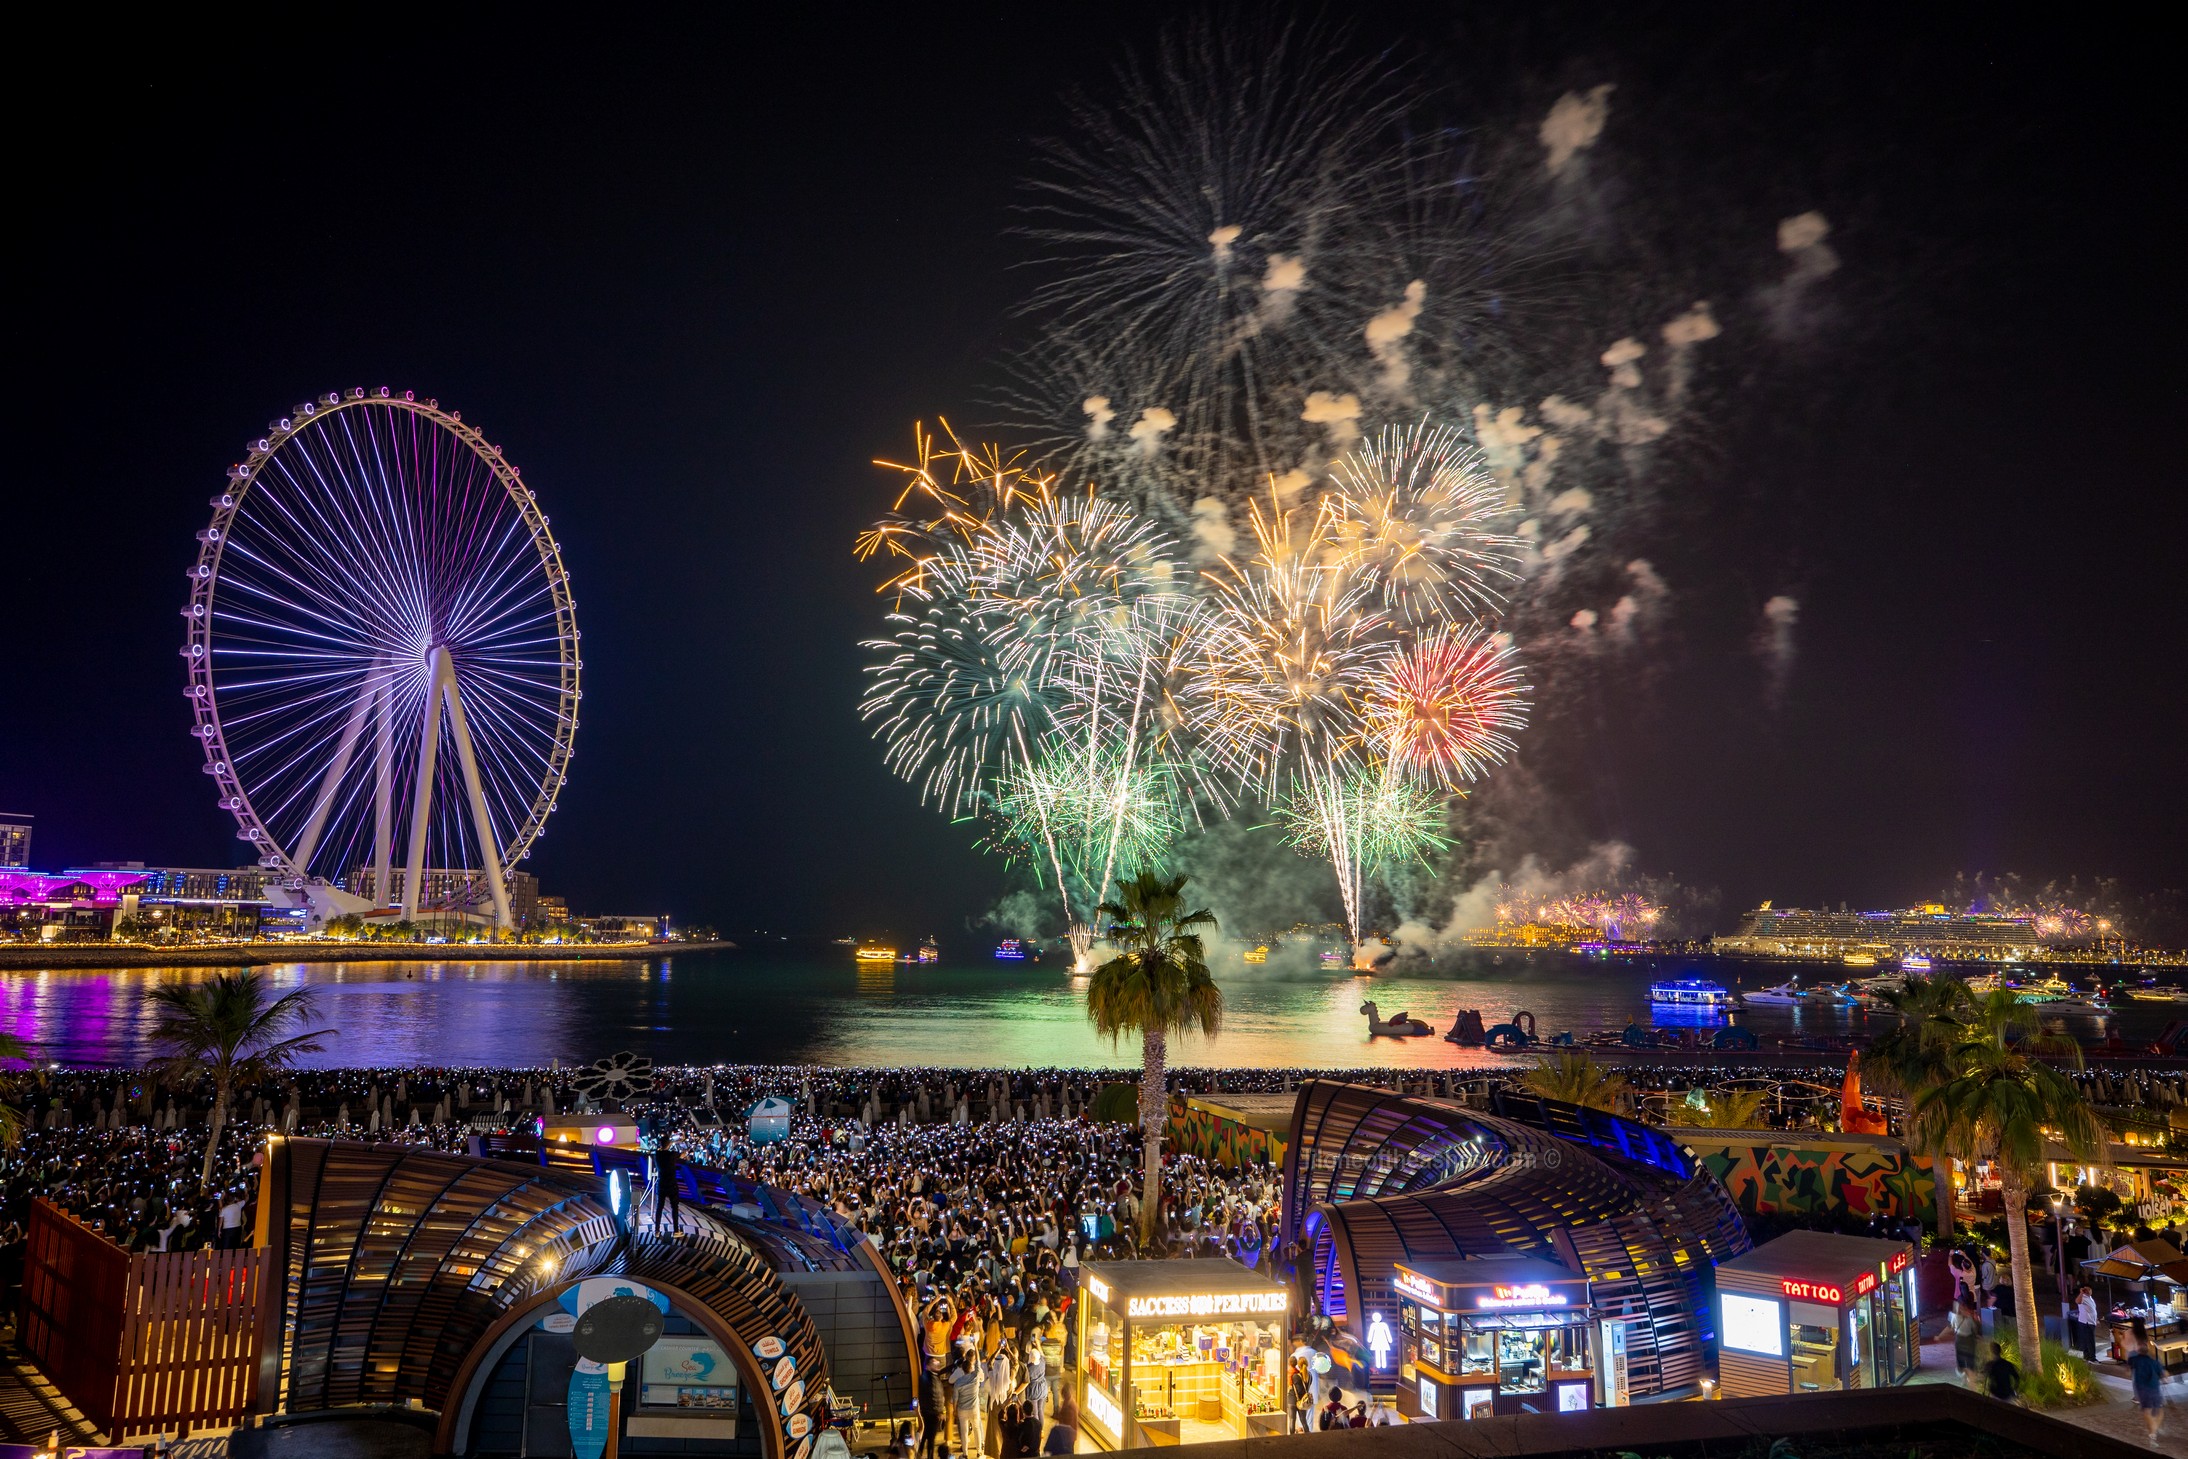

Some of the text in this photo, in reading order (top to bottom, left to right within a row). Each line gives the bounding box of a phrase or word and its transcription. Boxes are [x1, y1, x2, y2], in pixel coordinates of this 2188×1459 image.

[1783, 1281, 1840, 1302] TATTOO
[1858, 1273, 1874, 1294] TATTOO
[1129, 1296, 1189, 1316] SACCESS
[1213, 1293, 1287, 1313] PERFUMES
[764, 1347, 779, 1355] TOWELS
[664, 1367, 693, 1381] Breeze
[681, 1359, 697, 1373] Sea
[779, 1366, 794, 1387] SHOWERS
